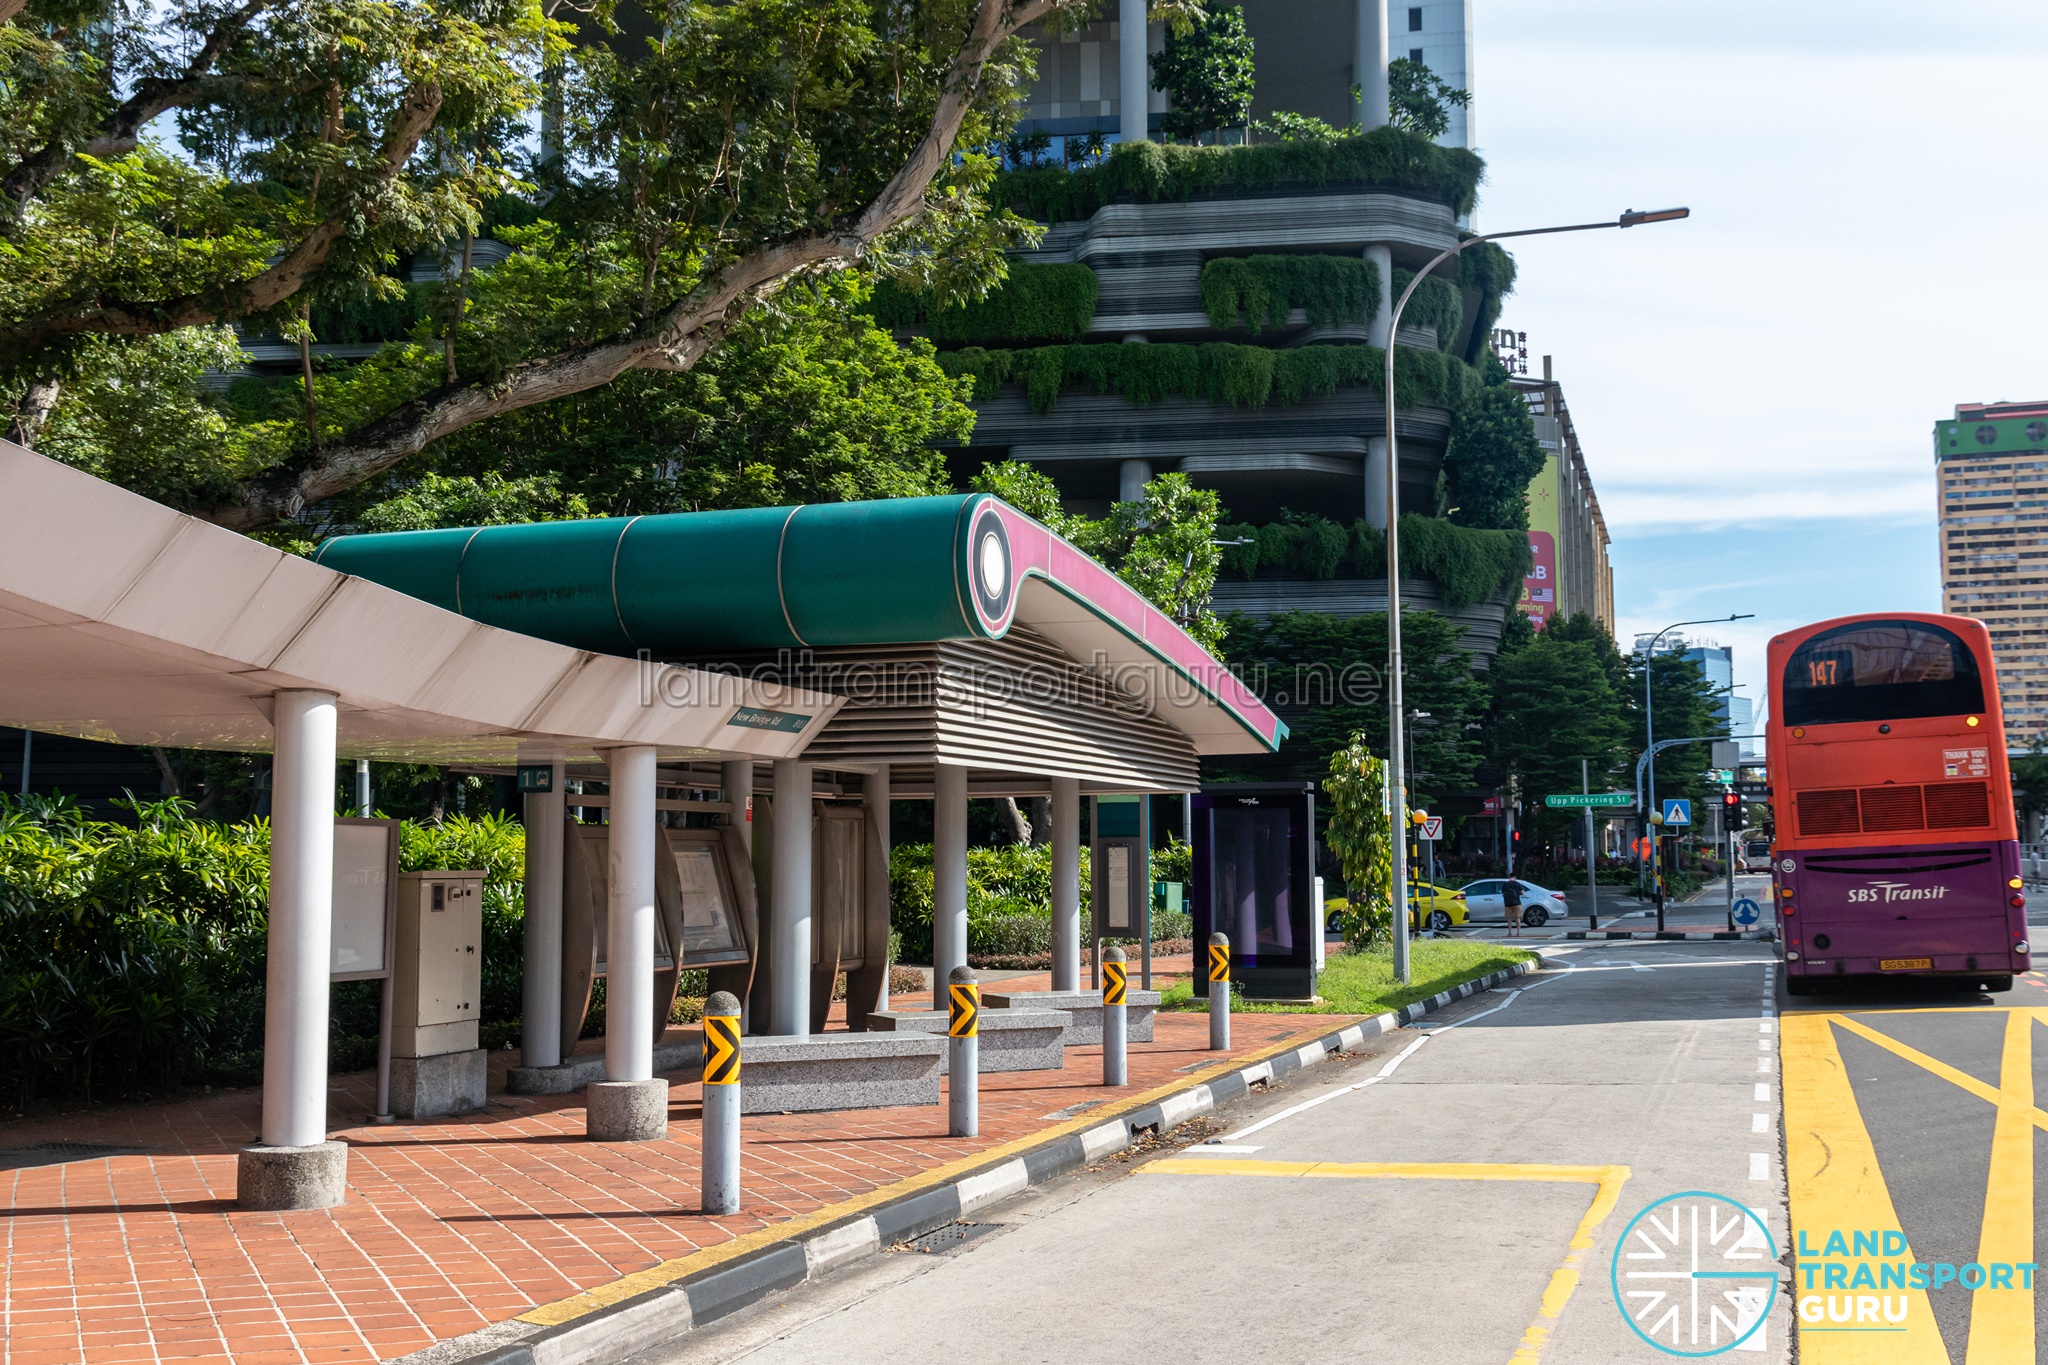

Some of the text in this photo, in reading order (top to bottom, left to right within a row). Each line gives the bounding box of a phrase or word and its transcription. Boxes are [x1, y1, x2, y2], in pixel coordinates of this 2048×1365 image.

[1809, 660, 1837, 686] 147
[733, 711, 784, 726] New Bridge Rd
[1945, 749, 1986, 759] THANK YOU
[523, 771, 529, 787] 1
[1550, 795, 1626, 805] Upp Pickering St
[1848, 883, 1950, 904] SBS Transit
[1884, 960, 1927, 969] SG5387P
